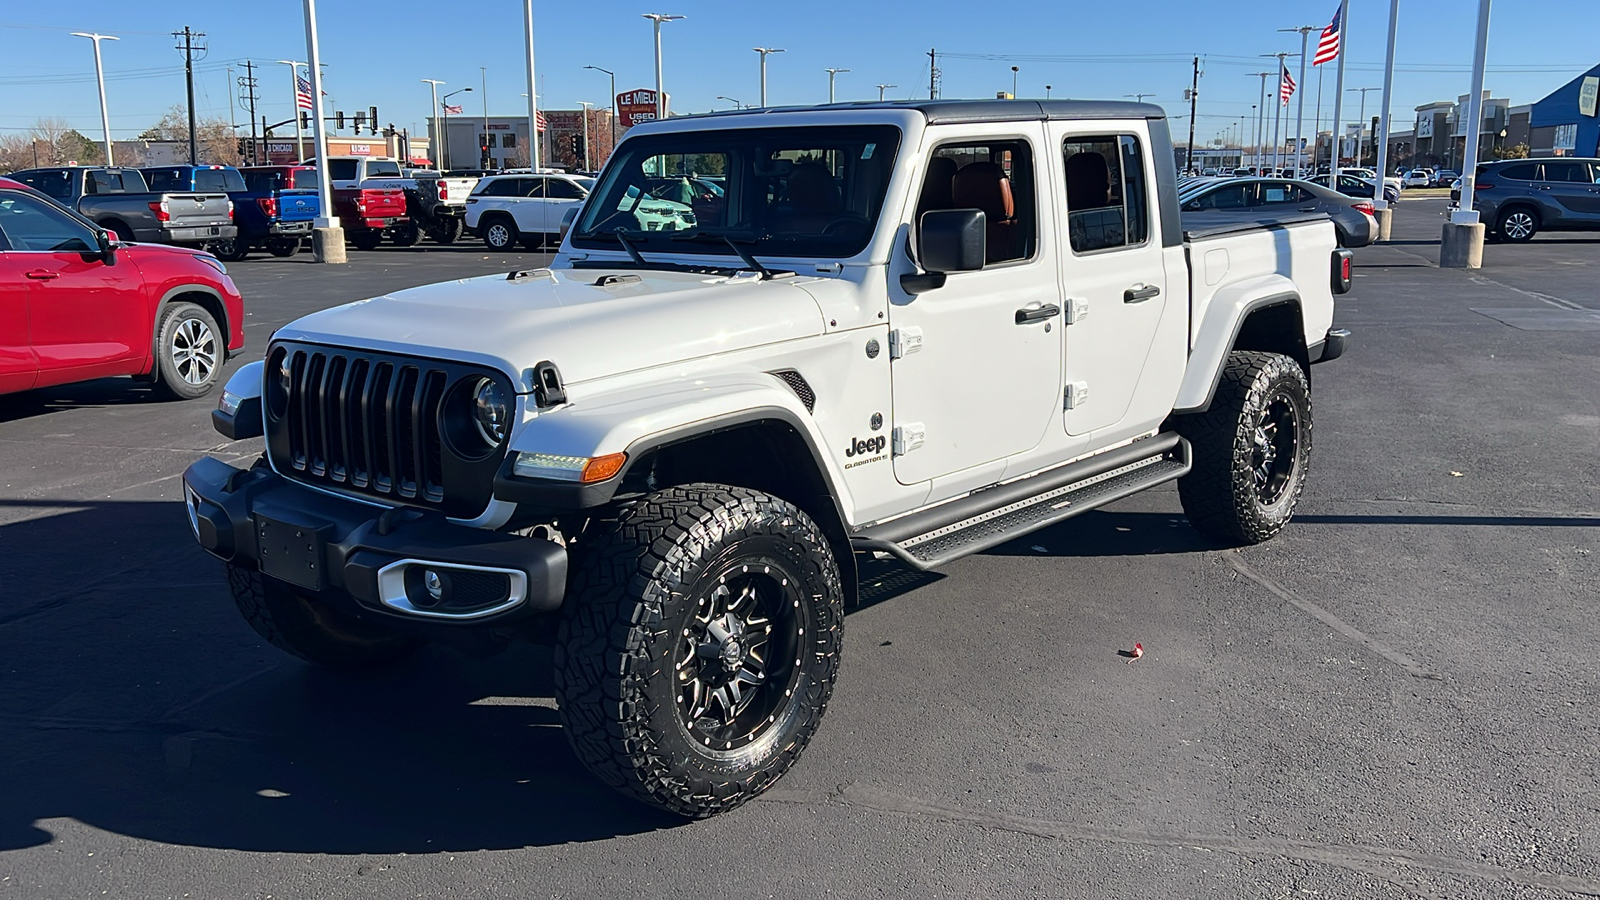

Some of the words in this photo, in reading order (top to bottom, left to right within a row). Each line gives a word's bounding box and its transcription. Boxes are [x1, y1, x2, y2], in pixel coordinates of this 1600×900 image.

[620, 94, 631, 104] LE
[633, 91, 657, 104] MIEU
[272, 144, 292, 152] CHICAGO
[846, 435, 886, 458] Jeep
[845, 456, 882, 470] GLADIATOR
